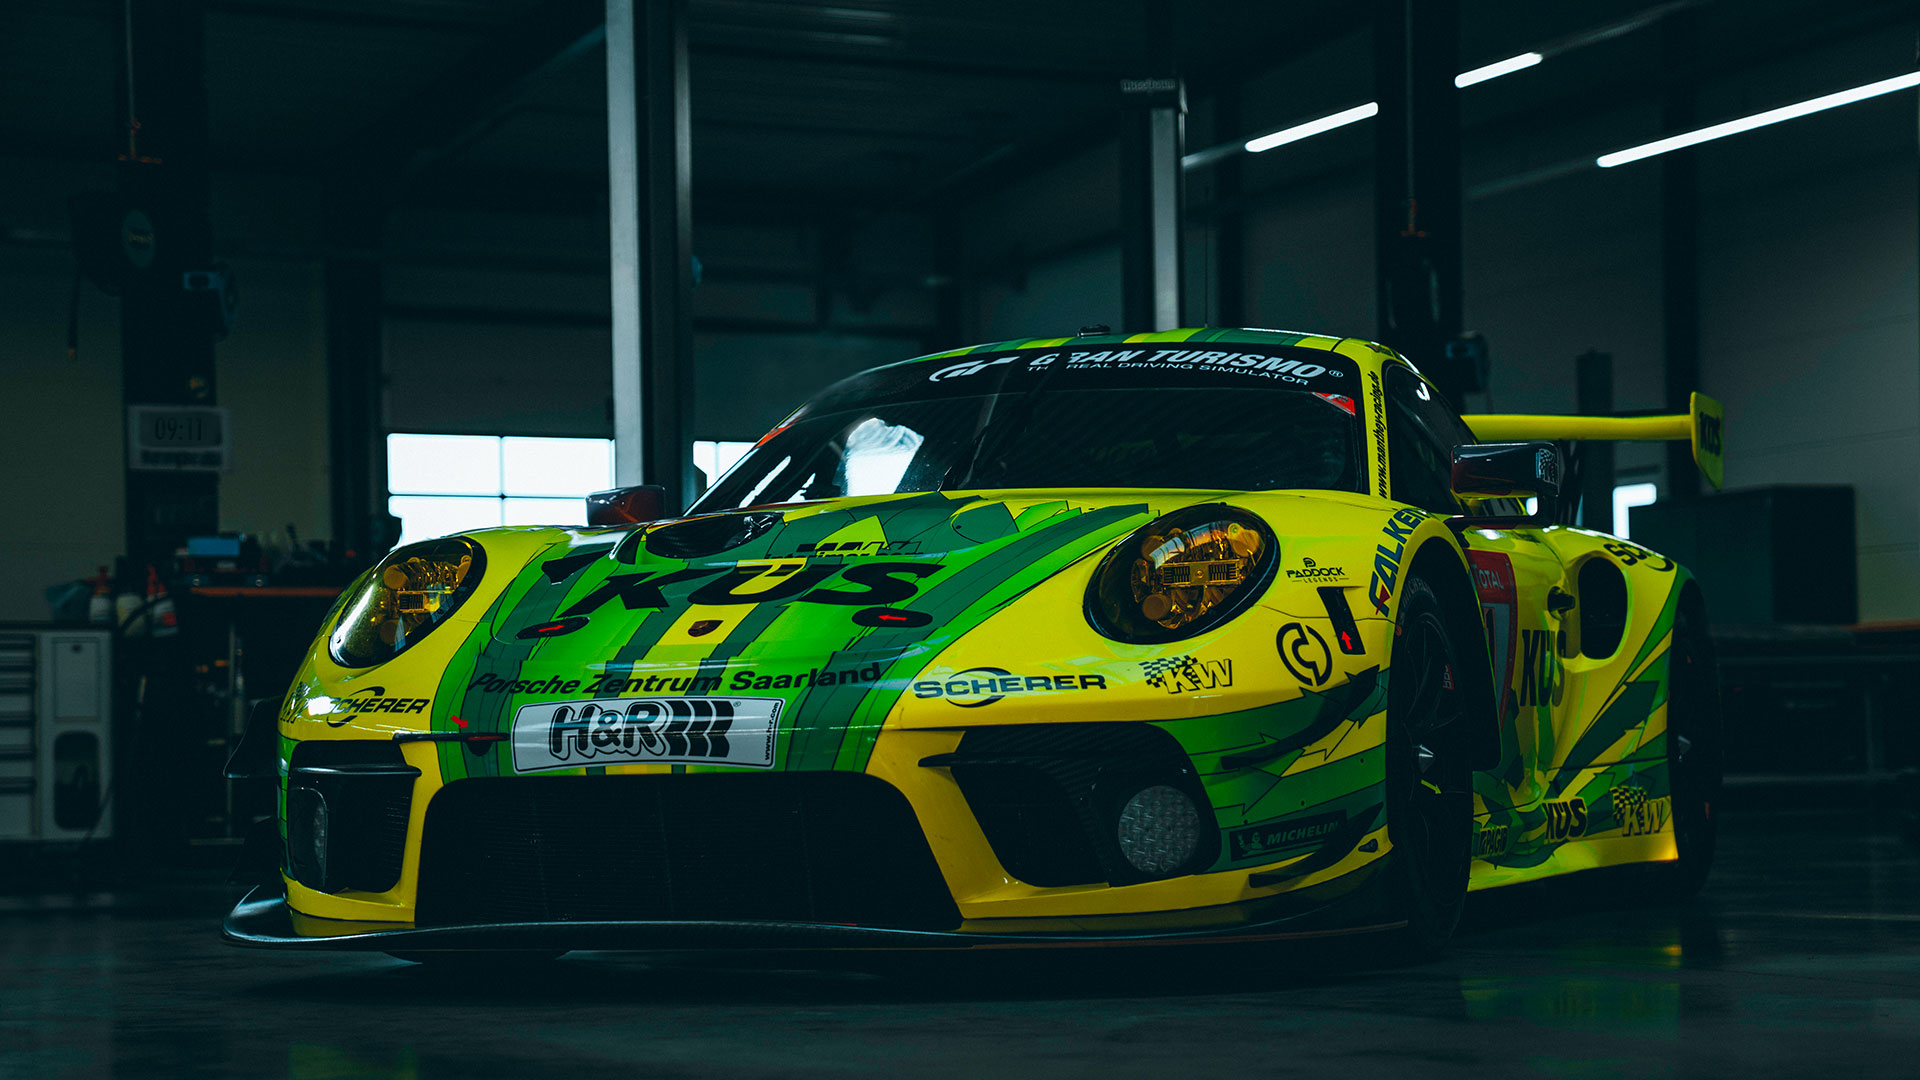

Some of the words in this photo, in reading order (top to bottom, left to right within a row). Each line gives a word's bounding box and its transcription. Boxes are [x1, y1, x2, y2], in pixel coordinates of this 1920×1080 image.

[1114, 362, 1194, 370] DRIVING
[1199, 365, 1309, 386] SIMULATOR
[1368, 371, 1387, 499] www.manthey-racing.de
[1286, 567, 1345, 578] PADDOCK
[468, 672, 580, 694] Porsche
[583, 673, 723, 693] Zentrum
[730, 662, 881, 691] Saarland
[913, 675, 1106, 698] SCHERER
[1162, 659, 1232, 694] KW
[550, 702, 669, 761] H&R
[765, 702, 779, 761] www.h-r.com
[1267, 821, 1338, 846] MICHELIN
